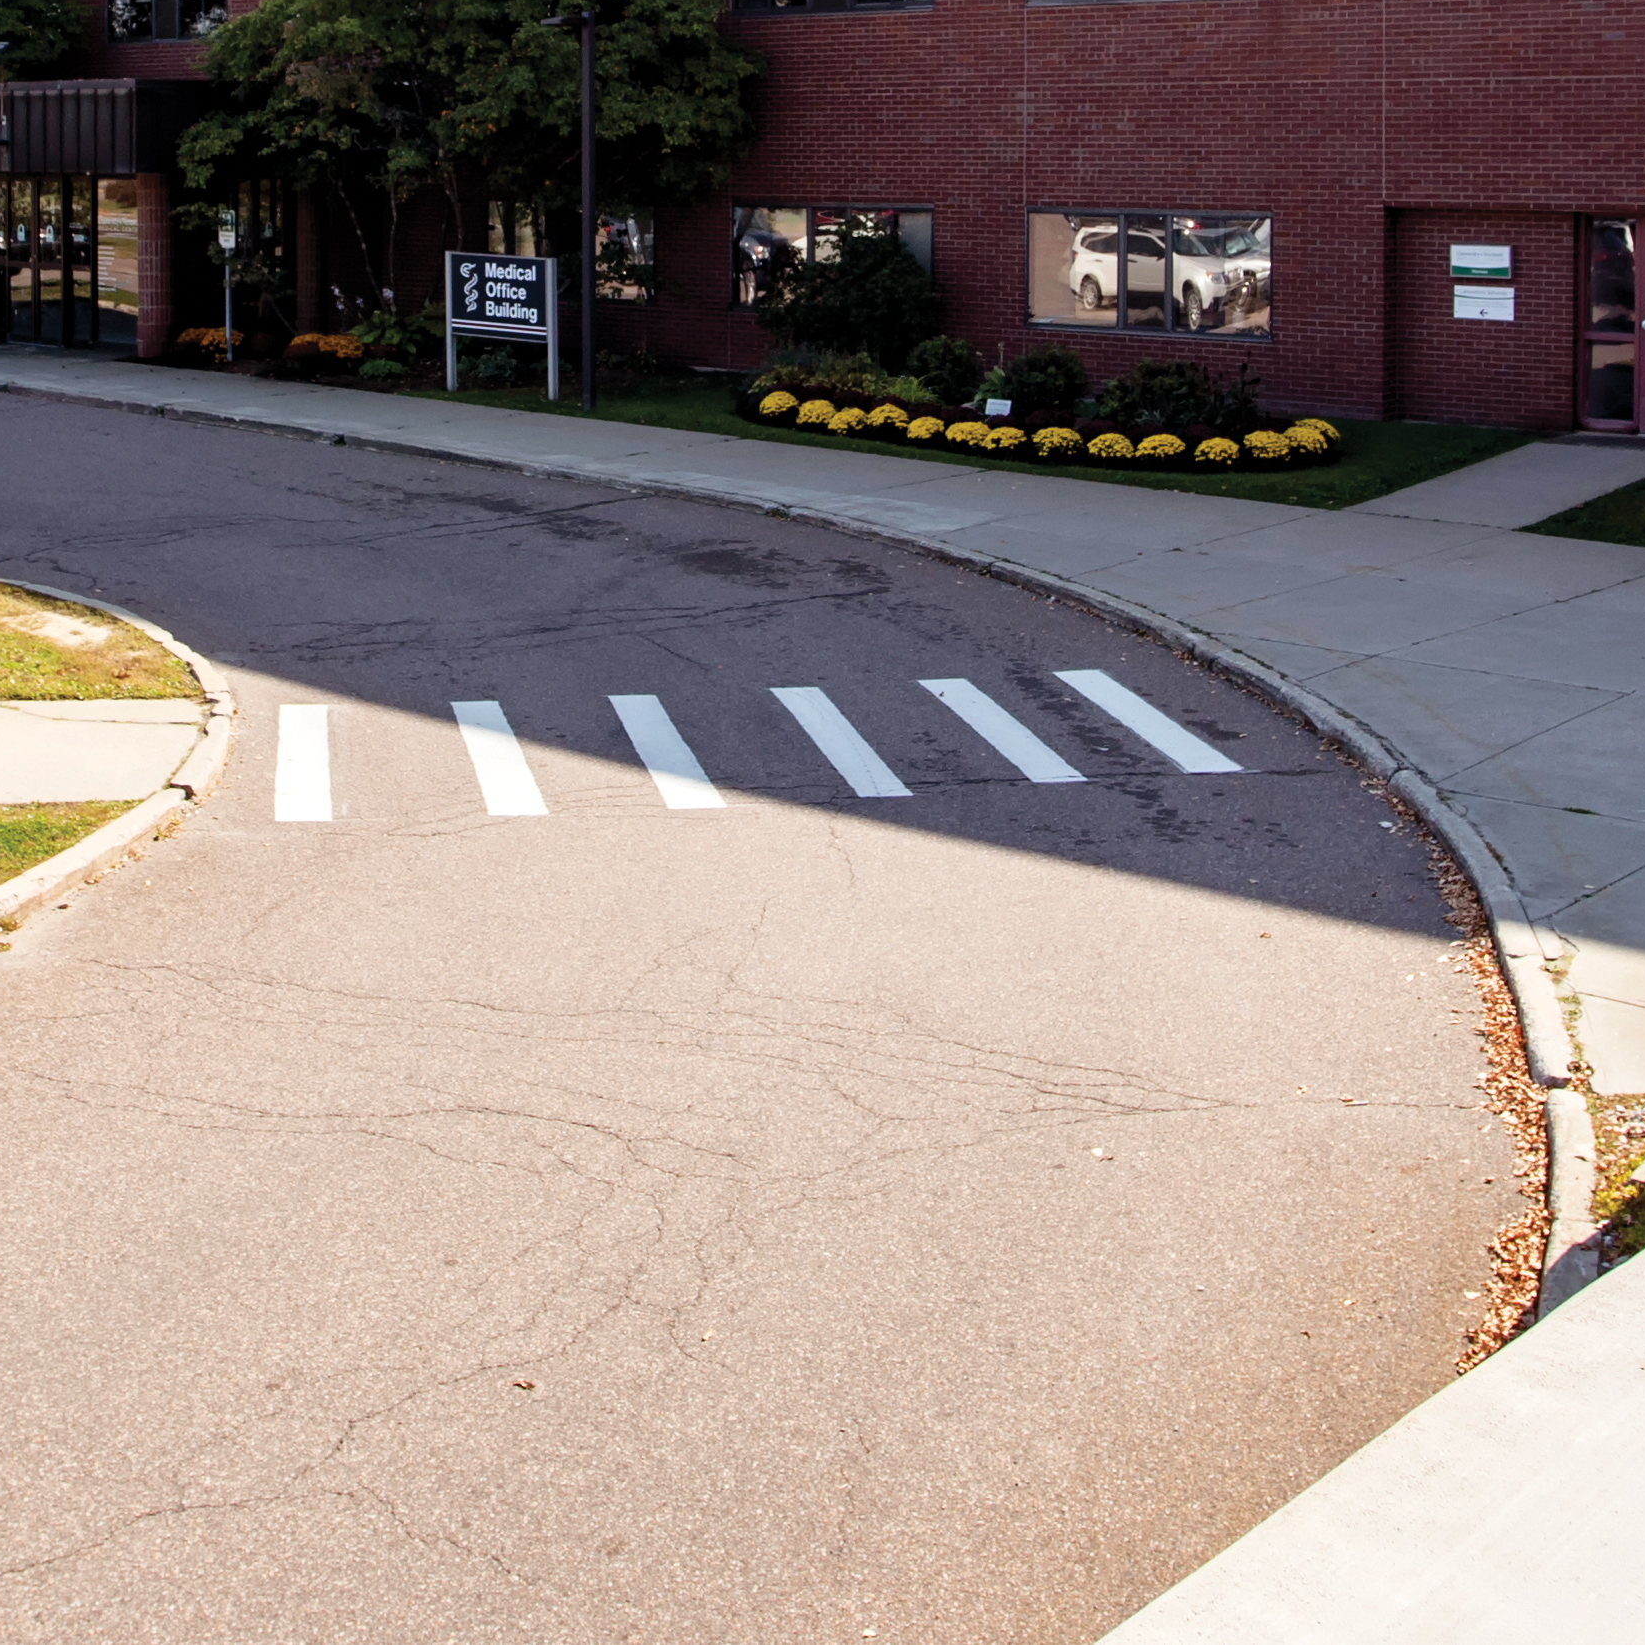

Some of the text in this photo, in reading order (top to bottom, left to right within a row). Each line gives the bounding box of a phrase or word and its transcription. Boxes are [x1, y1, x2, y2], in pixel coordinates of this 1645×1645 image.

[485, 262, 536, 281] Medical
[485, 281, 527, 300] Office
[485, 301, 538, 324] Building
